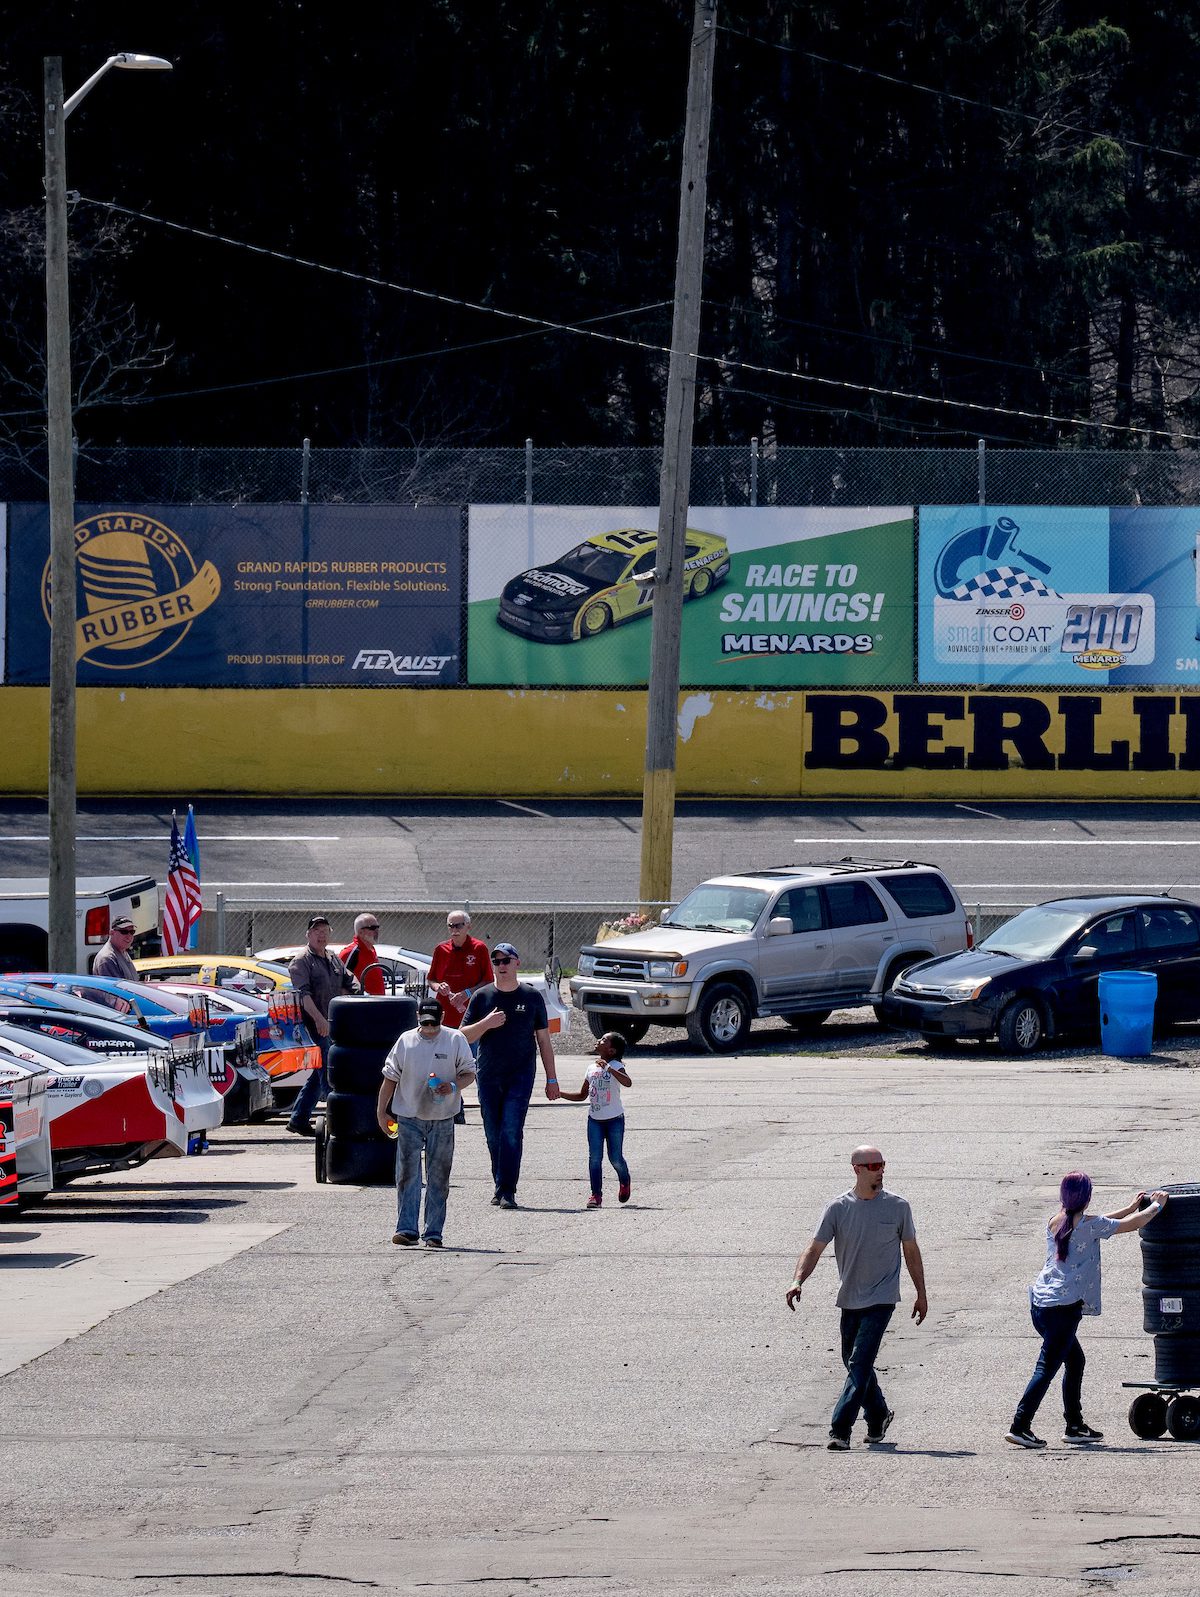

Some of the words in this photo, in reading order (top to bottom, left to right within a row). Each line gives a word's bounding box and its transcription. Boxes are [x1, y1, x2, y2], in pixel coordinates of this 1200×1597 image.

[97, 517, 182, 558] RAPIDS
[605, 529, 658, 550] 12
[237, 561, 282, 573] GRAND
[284, 561, 328, 573] RAPIDS
[331, 562, 378, 573] RUBBER
[381, 562, 447, 574] PRODUCTS
[745, 564, 818, 587] RACE
[825, 564, 858, 587] TO
[234, 580, 272, 593] Strong
[275, 580, 344, 591] Foundation.
[347, 581, 390, 591] Flexible
[394, 581, 450, 591] Solutions.
[304, 600, 379, 608] GRRUBBER.COM
[719, 593, 885, 622] SAVINGS!
[81, 594, 194, 643] RUBBER
[1060, 604, 1143, 653] 200
[722, 634, 873, 654] MENARDS
[947, 645, 979, 653] ADVANCED
[981, 645, 999, 653] PAINT
[227, 655, 262, 664] PROUD
[265, 655, 329, 664] DISTRIBUTOR
[332, 655, 345, 664] OF
[352, 650, 451, 675] FLEXAUST
[1073, 654, 1126, 664] MENARDS
